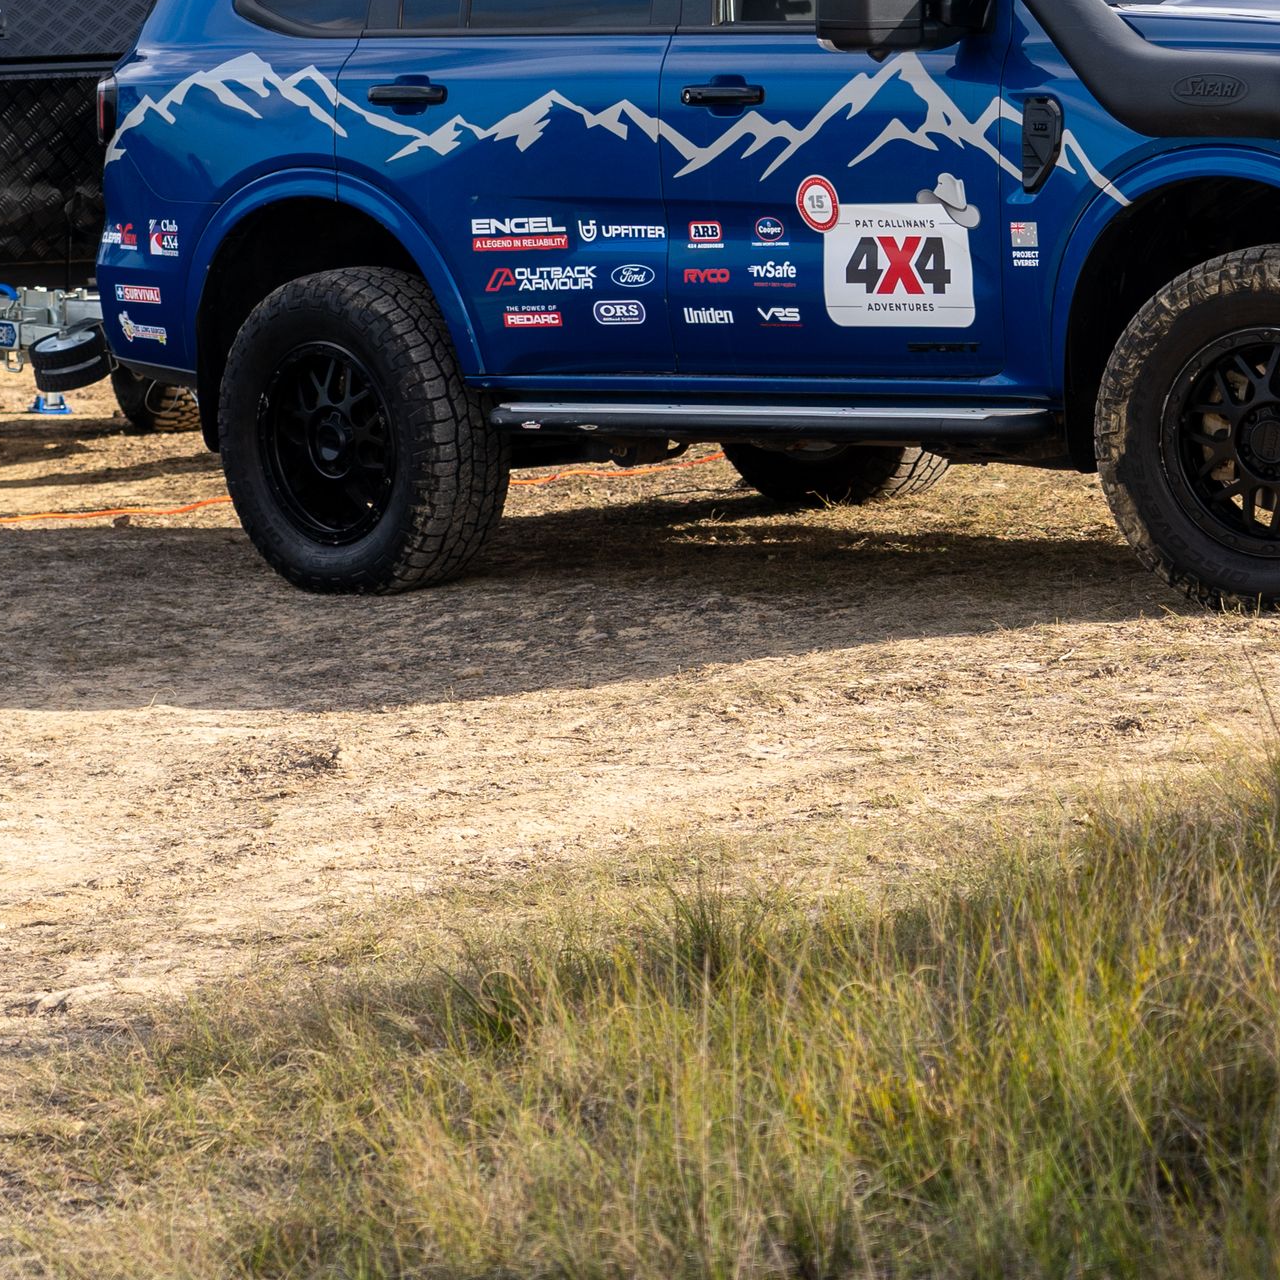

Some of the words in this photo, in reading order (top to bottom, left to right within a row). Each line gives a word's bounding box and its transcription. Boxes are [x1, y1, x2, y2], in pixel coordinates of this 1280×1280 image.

[1179, 77, 1241, 98] SAFARI
[161, 219, 178, 232] Club
[472, 217, 566, 234] ENGEL
[758, 225, 782, 235] Cooper
[854, 219, 874, 228] PAT
[877, 219, 936, 229] CALLINAN'S
[602, 225, 666, 238] UPFITTER
[693, 225, 719, 238] ARB
[162, 235, 179, 249] 4X4
[482, 240, 512, 249] LEGEND
[513, 240, 522, 248] IN
[523, 238, 566, 247] RELIABILITY
[1012, 251, 1040, 259] PROJECT
[752, 261, 797, 278] rvSafe
[845, 236, 952, 295] 4X4
[1013, 259, 1040, 267] EVEREST
[514, 266, 597, 279] OUTBACK
[619, 267, 647, 283] Ford
[683, 268, 730, 283] RYCO
[518, 278, 594, 291] ARMOUR
[124, 287, 160, 302] SURVIVAL
[599, 305, 640, 317] ORS
[866, 303, 936, 312] ADVENTURES
[507, 314, 560, 325] REDARC
[683, 307, 735, 324] Uniden
